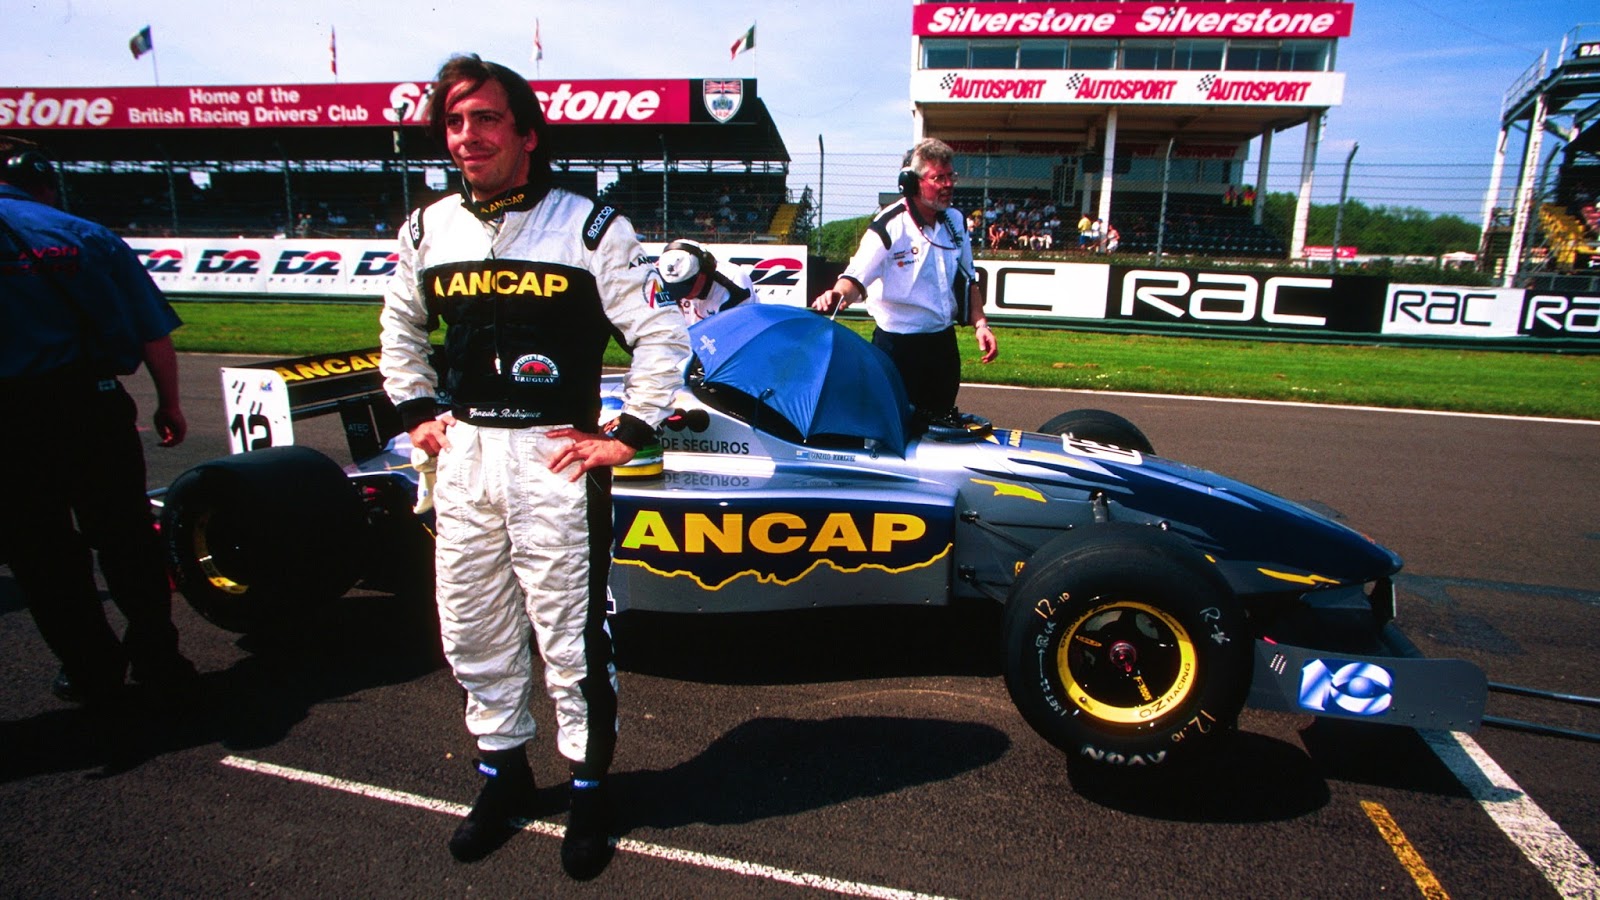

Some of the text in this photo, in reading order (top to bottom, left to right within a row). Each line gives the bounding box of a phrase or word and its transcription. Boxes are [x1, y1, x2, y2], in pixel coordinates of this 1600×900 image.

[928, 6, 1335, 33] Silverstone Silverstone
[189, 87, 300, 105] Home of the
[949, 77, 1047, 98] AUTOSPORT
[1075, 77, 1178, 99] AUTOSPORT
[1206, 79, 1312, 101] AUTOSPORT
[128, 104, 368, 126] British Racing Drivers' Club
[489, 193, 525, 213] ANCAP
[587, 205, 615, 240] sparco
[19, 246, 78, 260] AVON
[195, 249, 261, 274] D2
[272, 250, 342, 275] D2
[683, 438, 750, 455] SEGUROS
[621, 510, 926, 554] ANCAP
[1166, 662, 1191, 703] RACING
[1082, 745, 1167, 766] AVON
